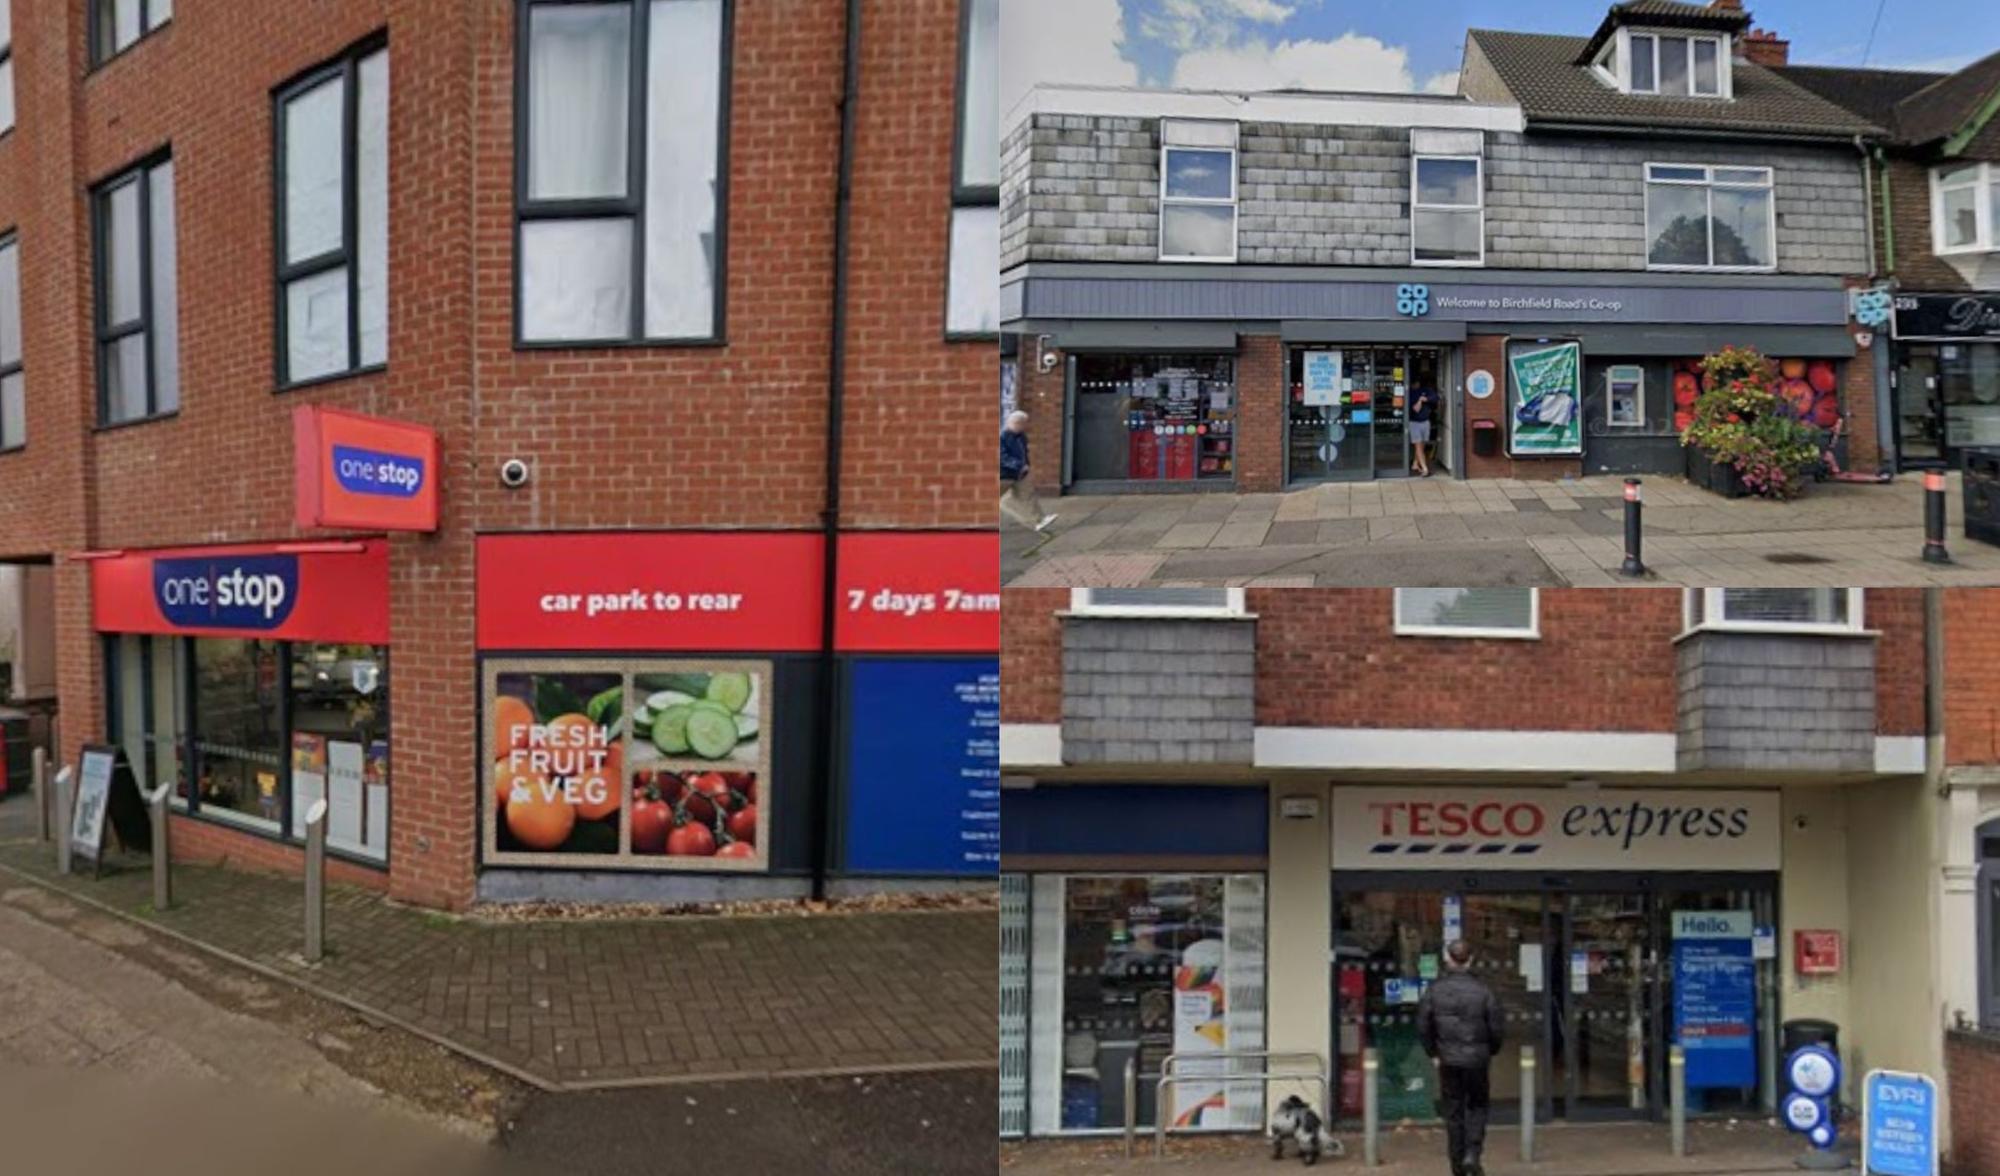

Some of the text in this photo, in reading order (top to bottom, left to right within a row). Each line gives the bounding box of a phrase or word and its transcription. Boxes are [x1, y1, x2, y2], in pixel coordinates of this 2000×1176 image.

[1437, 297, 1622, 312] Welcome to Birchfield Road's Co-op
[340, 459, 419, 491] one stop
[163, 567, 285, 619] one stop
[540, 589, 742, 617] car park to rear
[847, 588, 1000, 616] 7 days 7am
[510, 724, 609, 747] FRESH
[510, 749, 608, 774] FRUIT
[510, 776, 609, 805] & VEG
[1368, 801, 1749, 850] TESCO express
